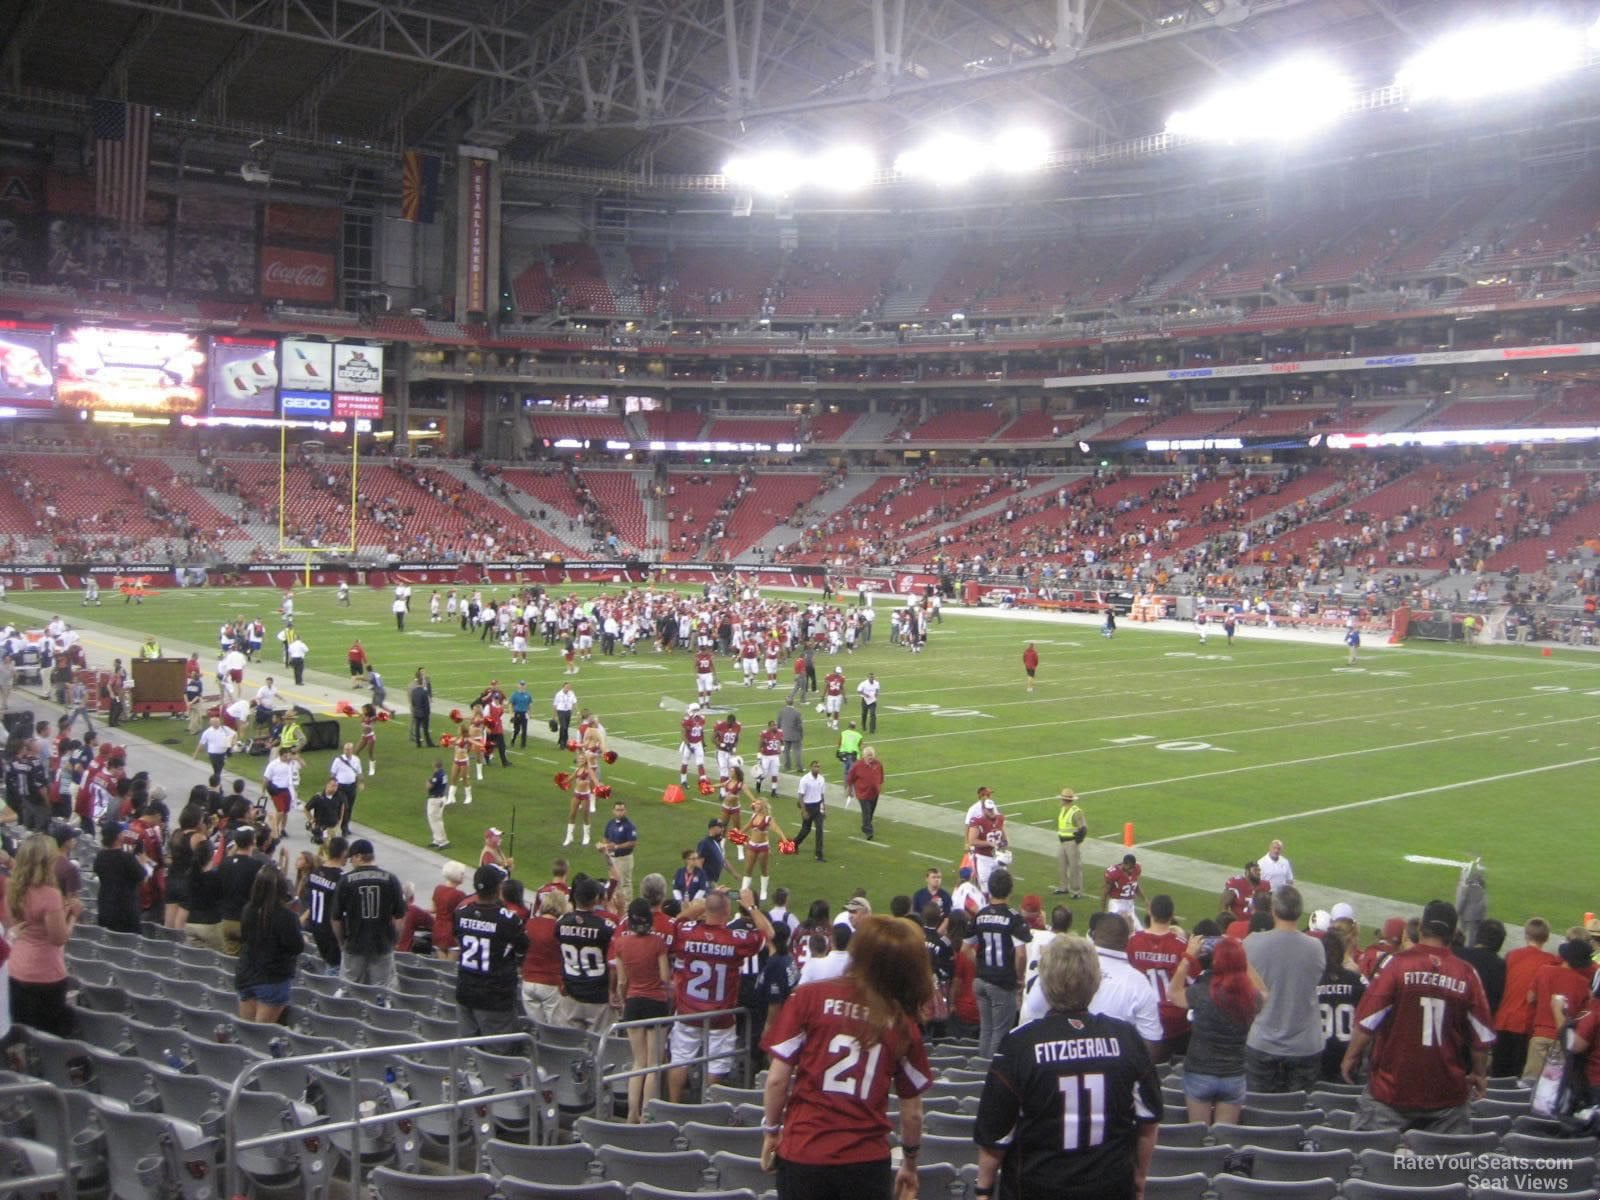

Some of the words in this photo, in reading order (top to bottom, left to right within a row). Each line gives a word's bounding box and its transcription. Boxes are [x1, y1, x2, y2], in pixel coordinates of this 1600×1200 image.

[472, 175, 481, 272] ESTABLISHED
[282, 397, 331, 409] GEICO
[310, 873, 337, 890] ITZGERALD
[311, 889, 325, 923] 11
[358, 885, 380, 918] 11
[459, 917, 497, 933] PETERSON
[559, 925, 599, 938] DOCKETT
[461, 935, 491, 972] 21
[560, 943, 606, 977] 80
[684, 940, 735, 957] PETERSON
[982, 932, 1004, 967] 11
[1134, 951, 1177, 964] FITZGERALD
[686, 959, 728, 1002] 21
[823, 998, 872, 1021] PETER
[1419, 996, 1446, 1047] 11
[822, 1033, 883, 1100] 21
[1034, 1037, 1121, 1064] FITZGERALD
[1058, 1073, 1105, 1150] 11
